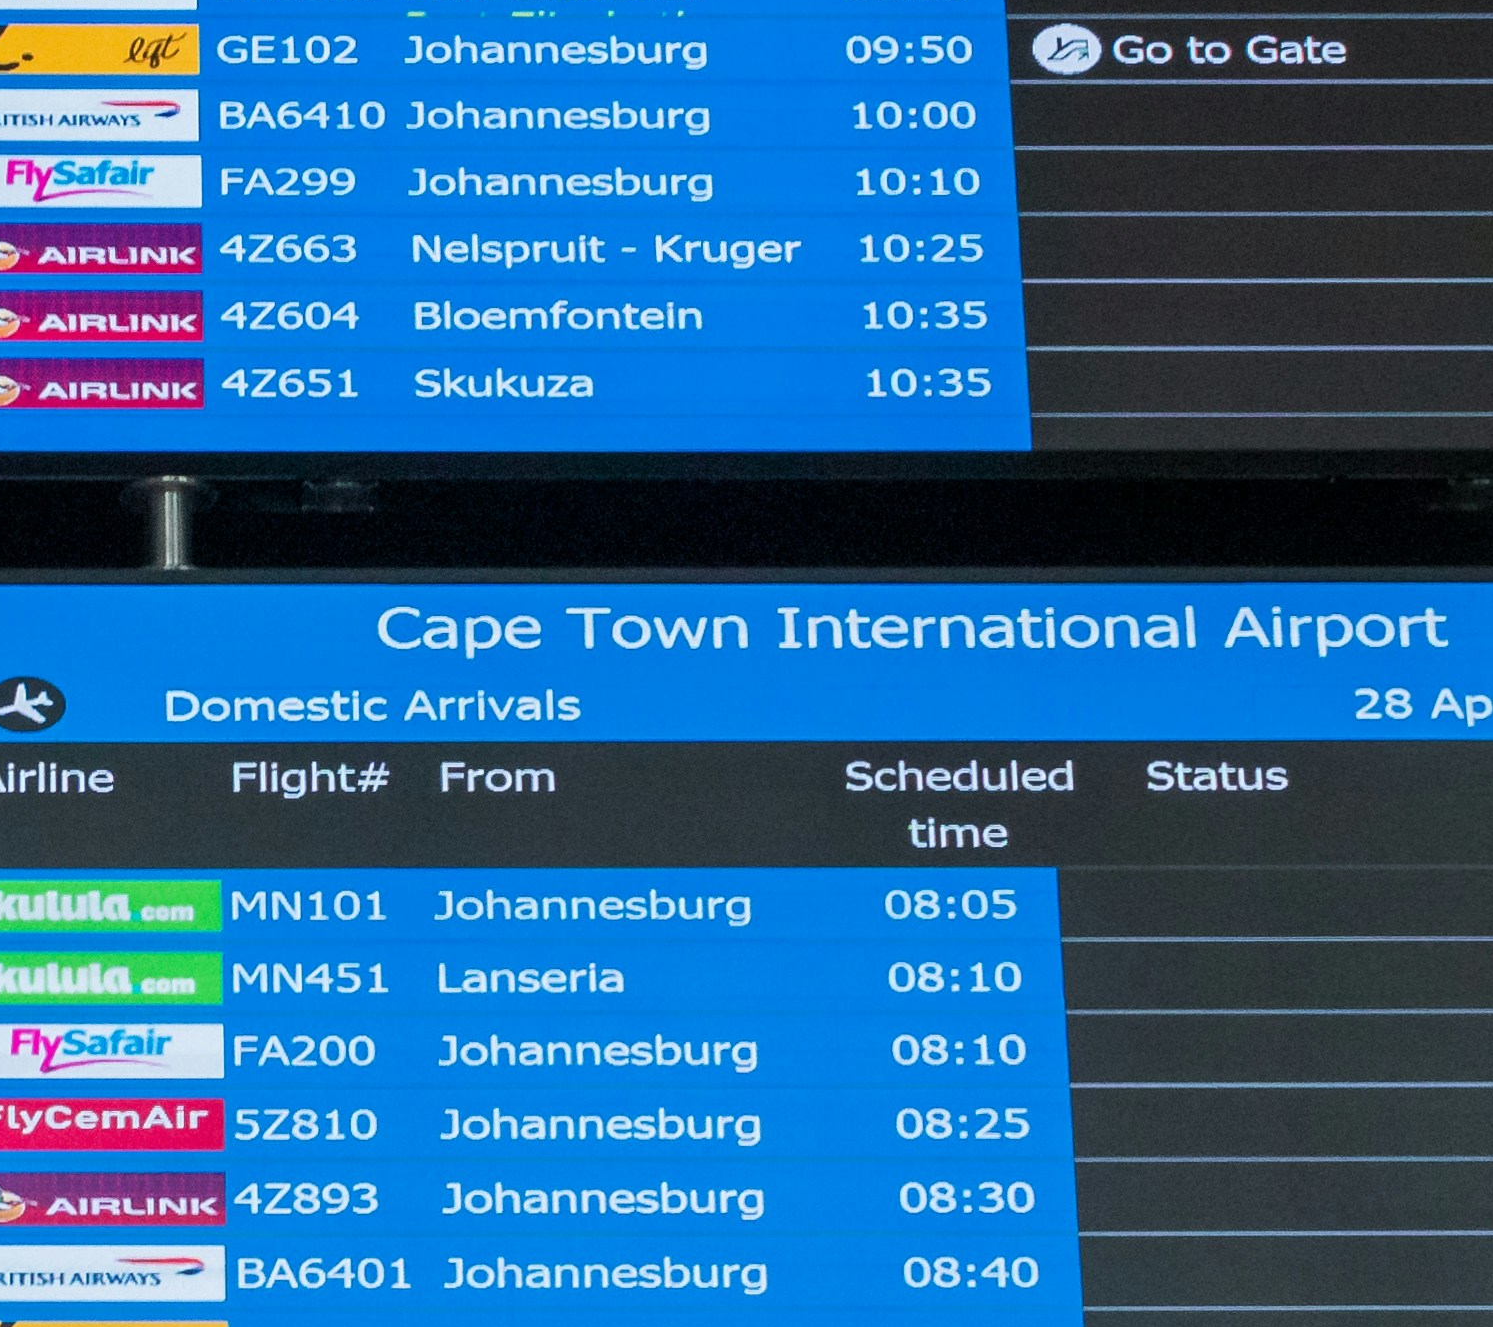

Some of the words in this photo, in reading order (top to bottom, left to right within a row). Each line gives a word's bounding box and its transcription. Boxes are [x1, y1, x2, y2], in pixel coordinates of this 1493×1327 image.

[218, 36, 357, 63] GE102
[405, 36, 706, 69] Johannesburg
[847, 36, 972, 63] 09:50
[1114, 36, 1173, 64] Go
[1187, 37, 1232, 64] to
[1248, 35, 1347, 64] Gate
[38, 246, 197, 265] AIRLINK
[220, 235, 356, 262] 4Z663
[413, 234, 605, 268] Nelspruit
[656, 235, 801, 268] Kruger
[861, 235, 983, 262] 10:25
[378, 607, 541, 658] Cape
[566, 608, 748, 648] Town
[778, 606, 1195, 648] International
[1225, 607, 1448, 656] Airport
[167, 691, 386, 721] Domestic
[405, 690, 580, 720] Arrivals
[1356, 689, 1412, 719] 28
[232, 891, 385, 920] MN101
[435, 890, 750, 926] Johannesburg
[886, 890, 1016, 919] 08:05
[234, 964, 388, 992] MN451
[439, 963, 623, 992] Lanseria
[889, 962, 1021, 992] 08:10
